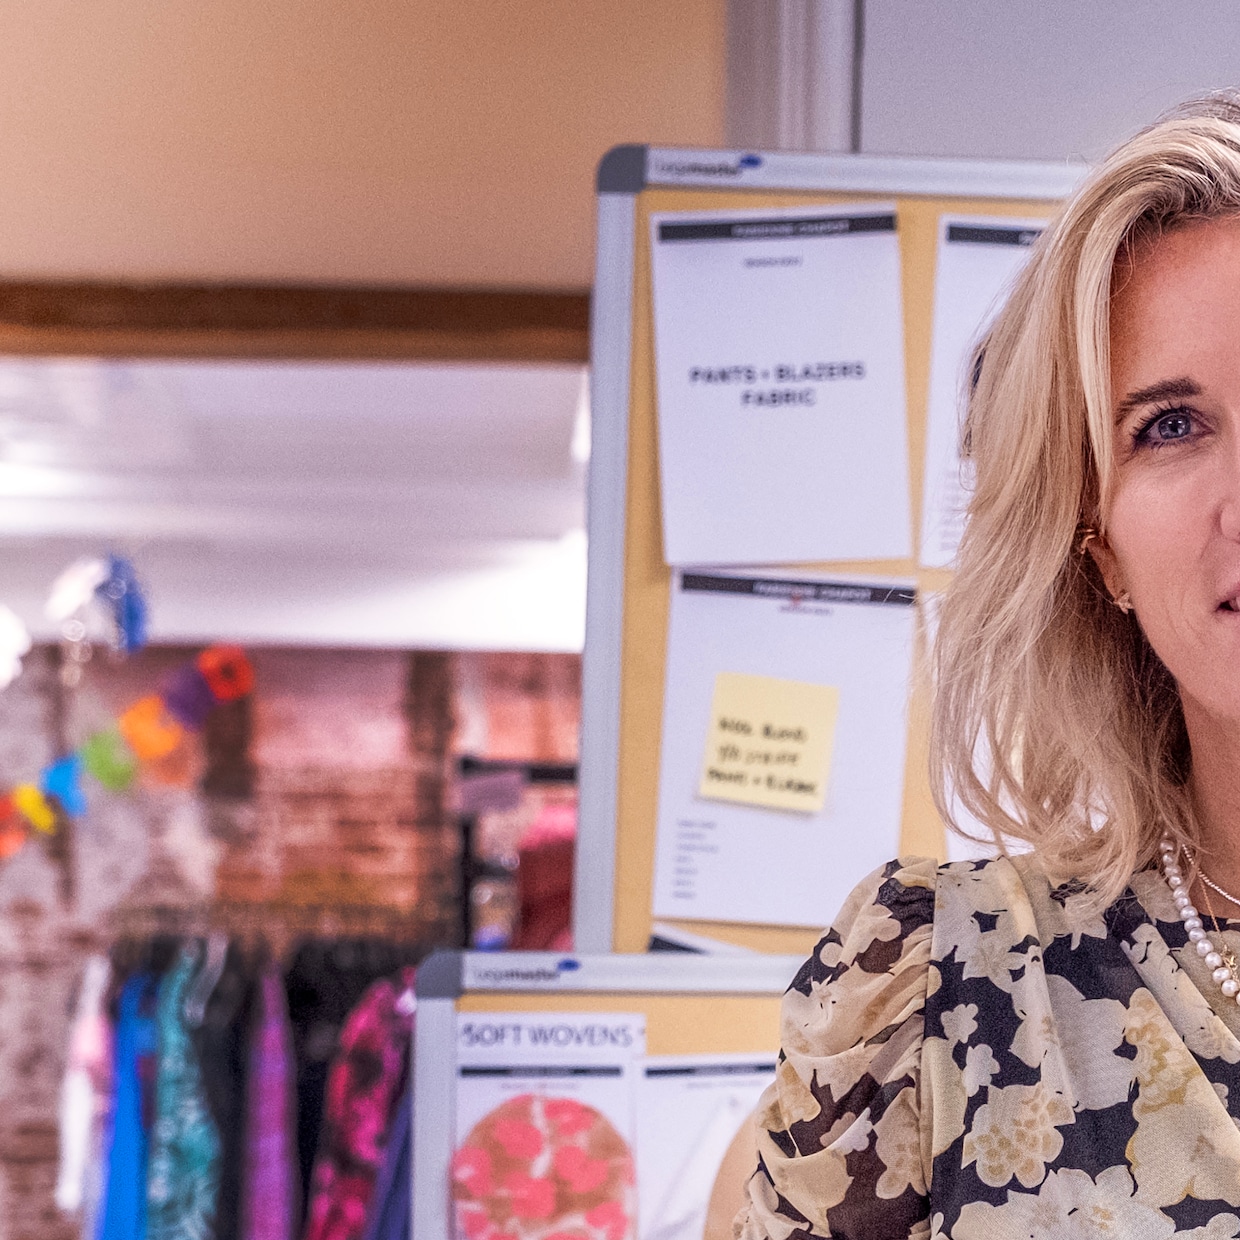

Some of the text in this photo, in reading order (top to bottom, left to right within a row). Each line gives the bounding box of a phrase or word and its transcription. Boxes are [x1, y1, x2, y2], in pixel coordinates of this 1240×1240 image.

[690, 367, 756, 384] PANTS
[775, 362, 866, 383] BLAZERS
[741, 389, 815, 407] FABRIC
[462, 1023, 633, 1048] SOFT WOVENS
